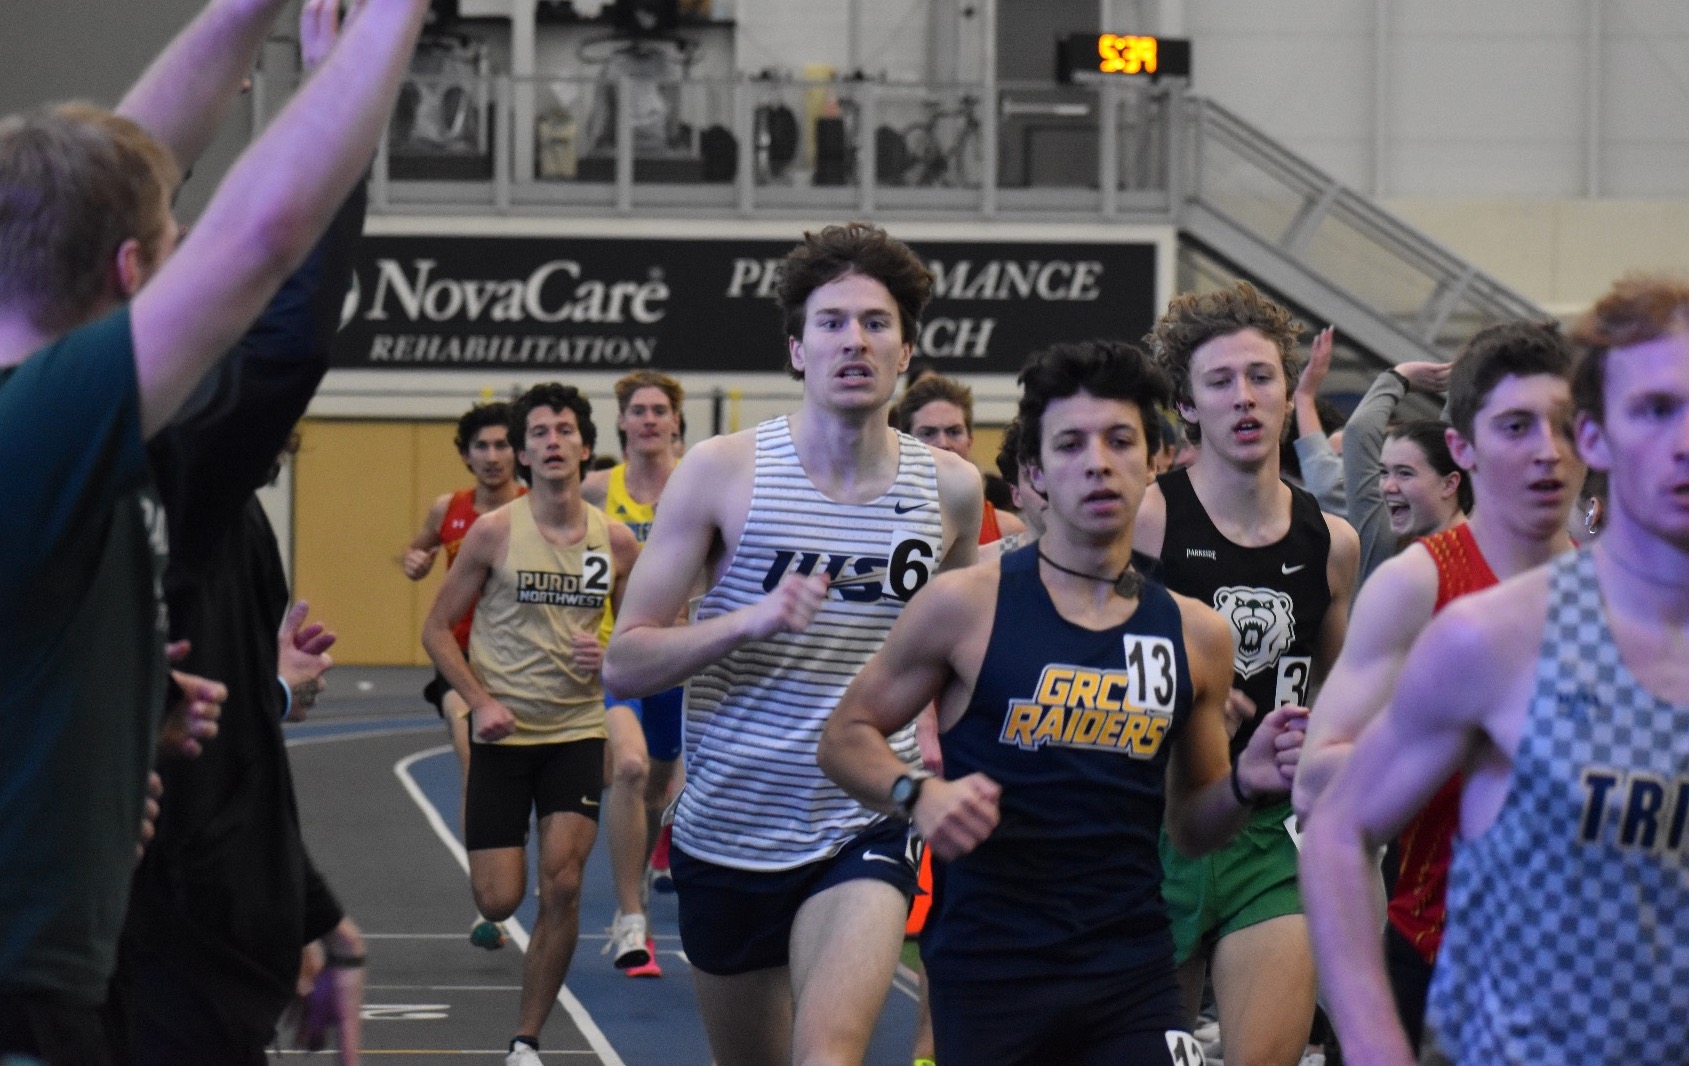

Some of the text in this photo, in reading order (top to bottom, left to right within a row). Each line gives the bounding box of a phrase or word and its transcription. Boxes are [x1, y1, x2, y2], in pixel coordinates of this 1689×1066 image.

[365, 259, 669, 323] NovaCare
[726, 258, 1104, 300] PEMANCE
[369, 335, 656, 363] REHABILITATION
[584, 556, 608, 590] 2
[890, 539, 933, 602] 6
[1186, 548, 1217, 560] PARKSIDE
[518, 589, 604, 608] NORTHWEST
[520, 572, 584, 593] PURD
[1036, 667, 1145, 713] GRC
[1128, 641, 1173, 706] 13
[1003, 703, 1170, 756] RAIDERS
